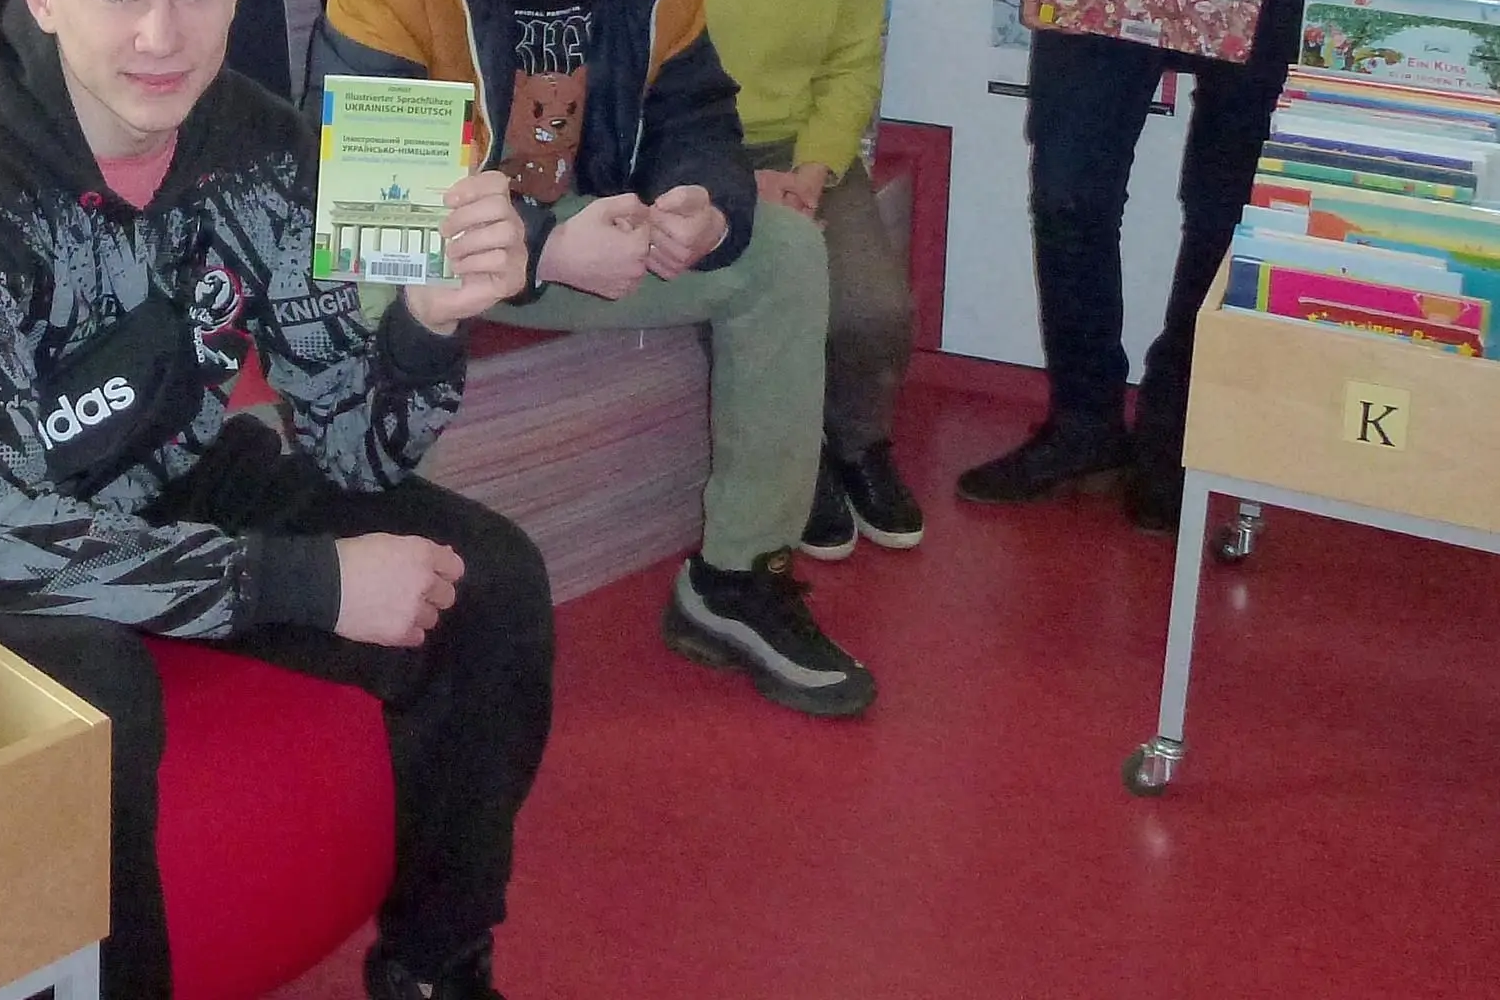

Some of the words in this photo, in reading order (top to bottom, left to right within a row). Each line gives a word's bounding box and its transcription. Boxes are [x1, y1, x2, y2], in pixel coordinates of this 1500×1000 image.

[345, 103, 404, 113] UKRAINISCH
[407, 106, 453, 117] DEUTSCH
[37, 376, 136, 450] idas
[1356, 400, 1397, 448] K
